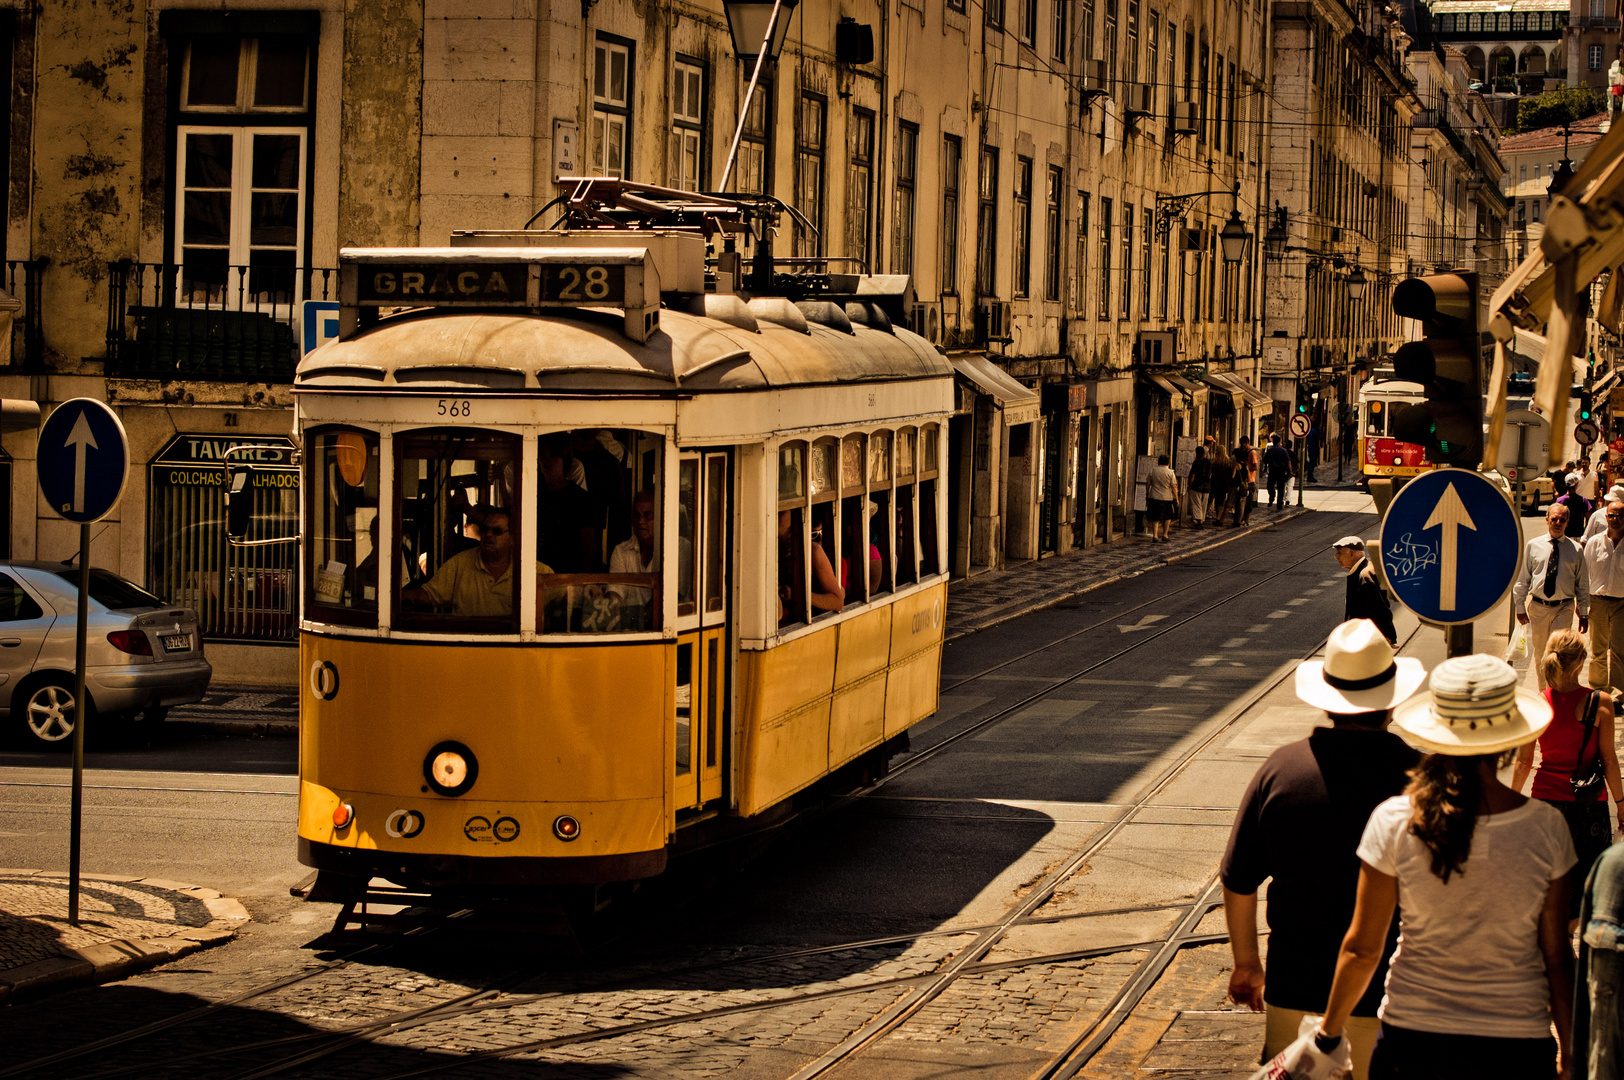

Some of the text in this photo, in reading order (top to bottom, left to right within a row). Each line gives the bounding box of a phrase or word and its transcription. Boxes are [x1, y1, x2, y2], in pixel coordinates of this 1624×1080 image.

[373, 271, 509, 296] GRAÇA
[558, 266, 610, 300] 28
[437, 400, 471, 417] 568
[224, 413, 238, 427] 71
[188, 440, 284, 461] TAVARES
